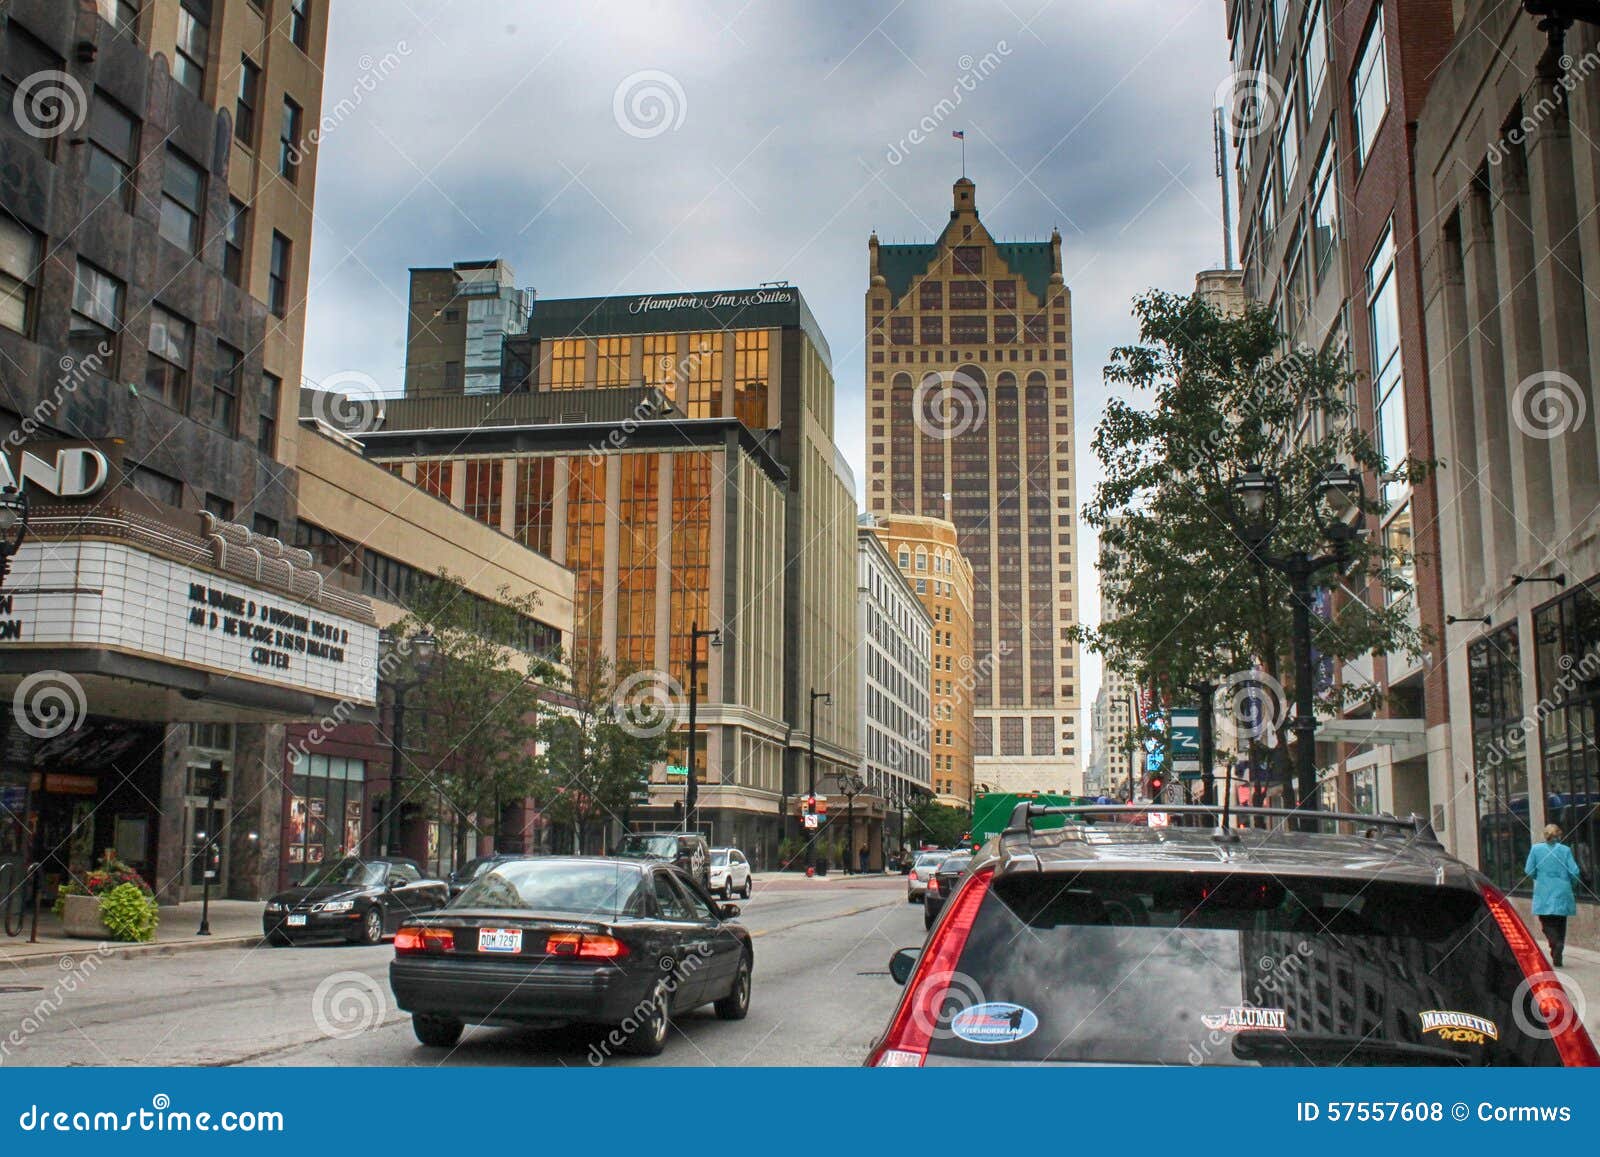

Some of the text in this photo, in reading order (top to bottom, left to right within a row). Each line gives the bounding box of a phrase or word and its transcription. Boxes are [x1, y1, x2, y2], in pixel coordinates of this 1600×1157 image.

[629, 295, 703, 314] Hampton
[704, 293, 743, 309] Inn
[751, 291, 792, 305] Suites
[189, 606, 218, 630] AND
[251, 646, 290, 669] CENTER
[1228, 1008, 1286, 1028] ALUMNI
[1422, 1012, 1496, 1037] MARQUETTE
